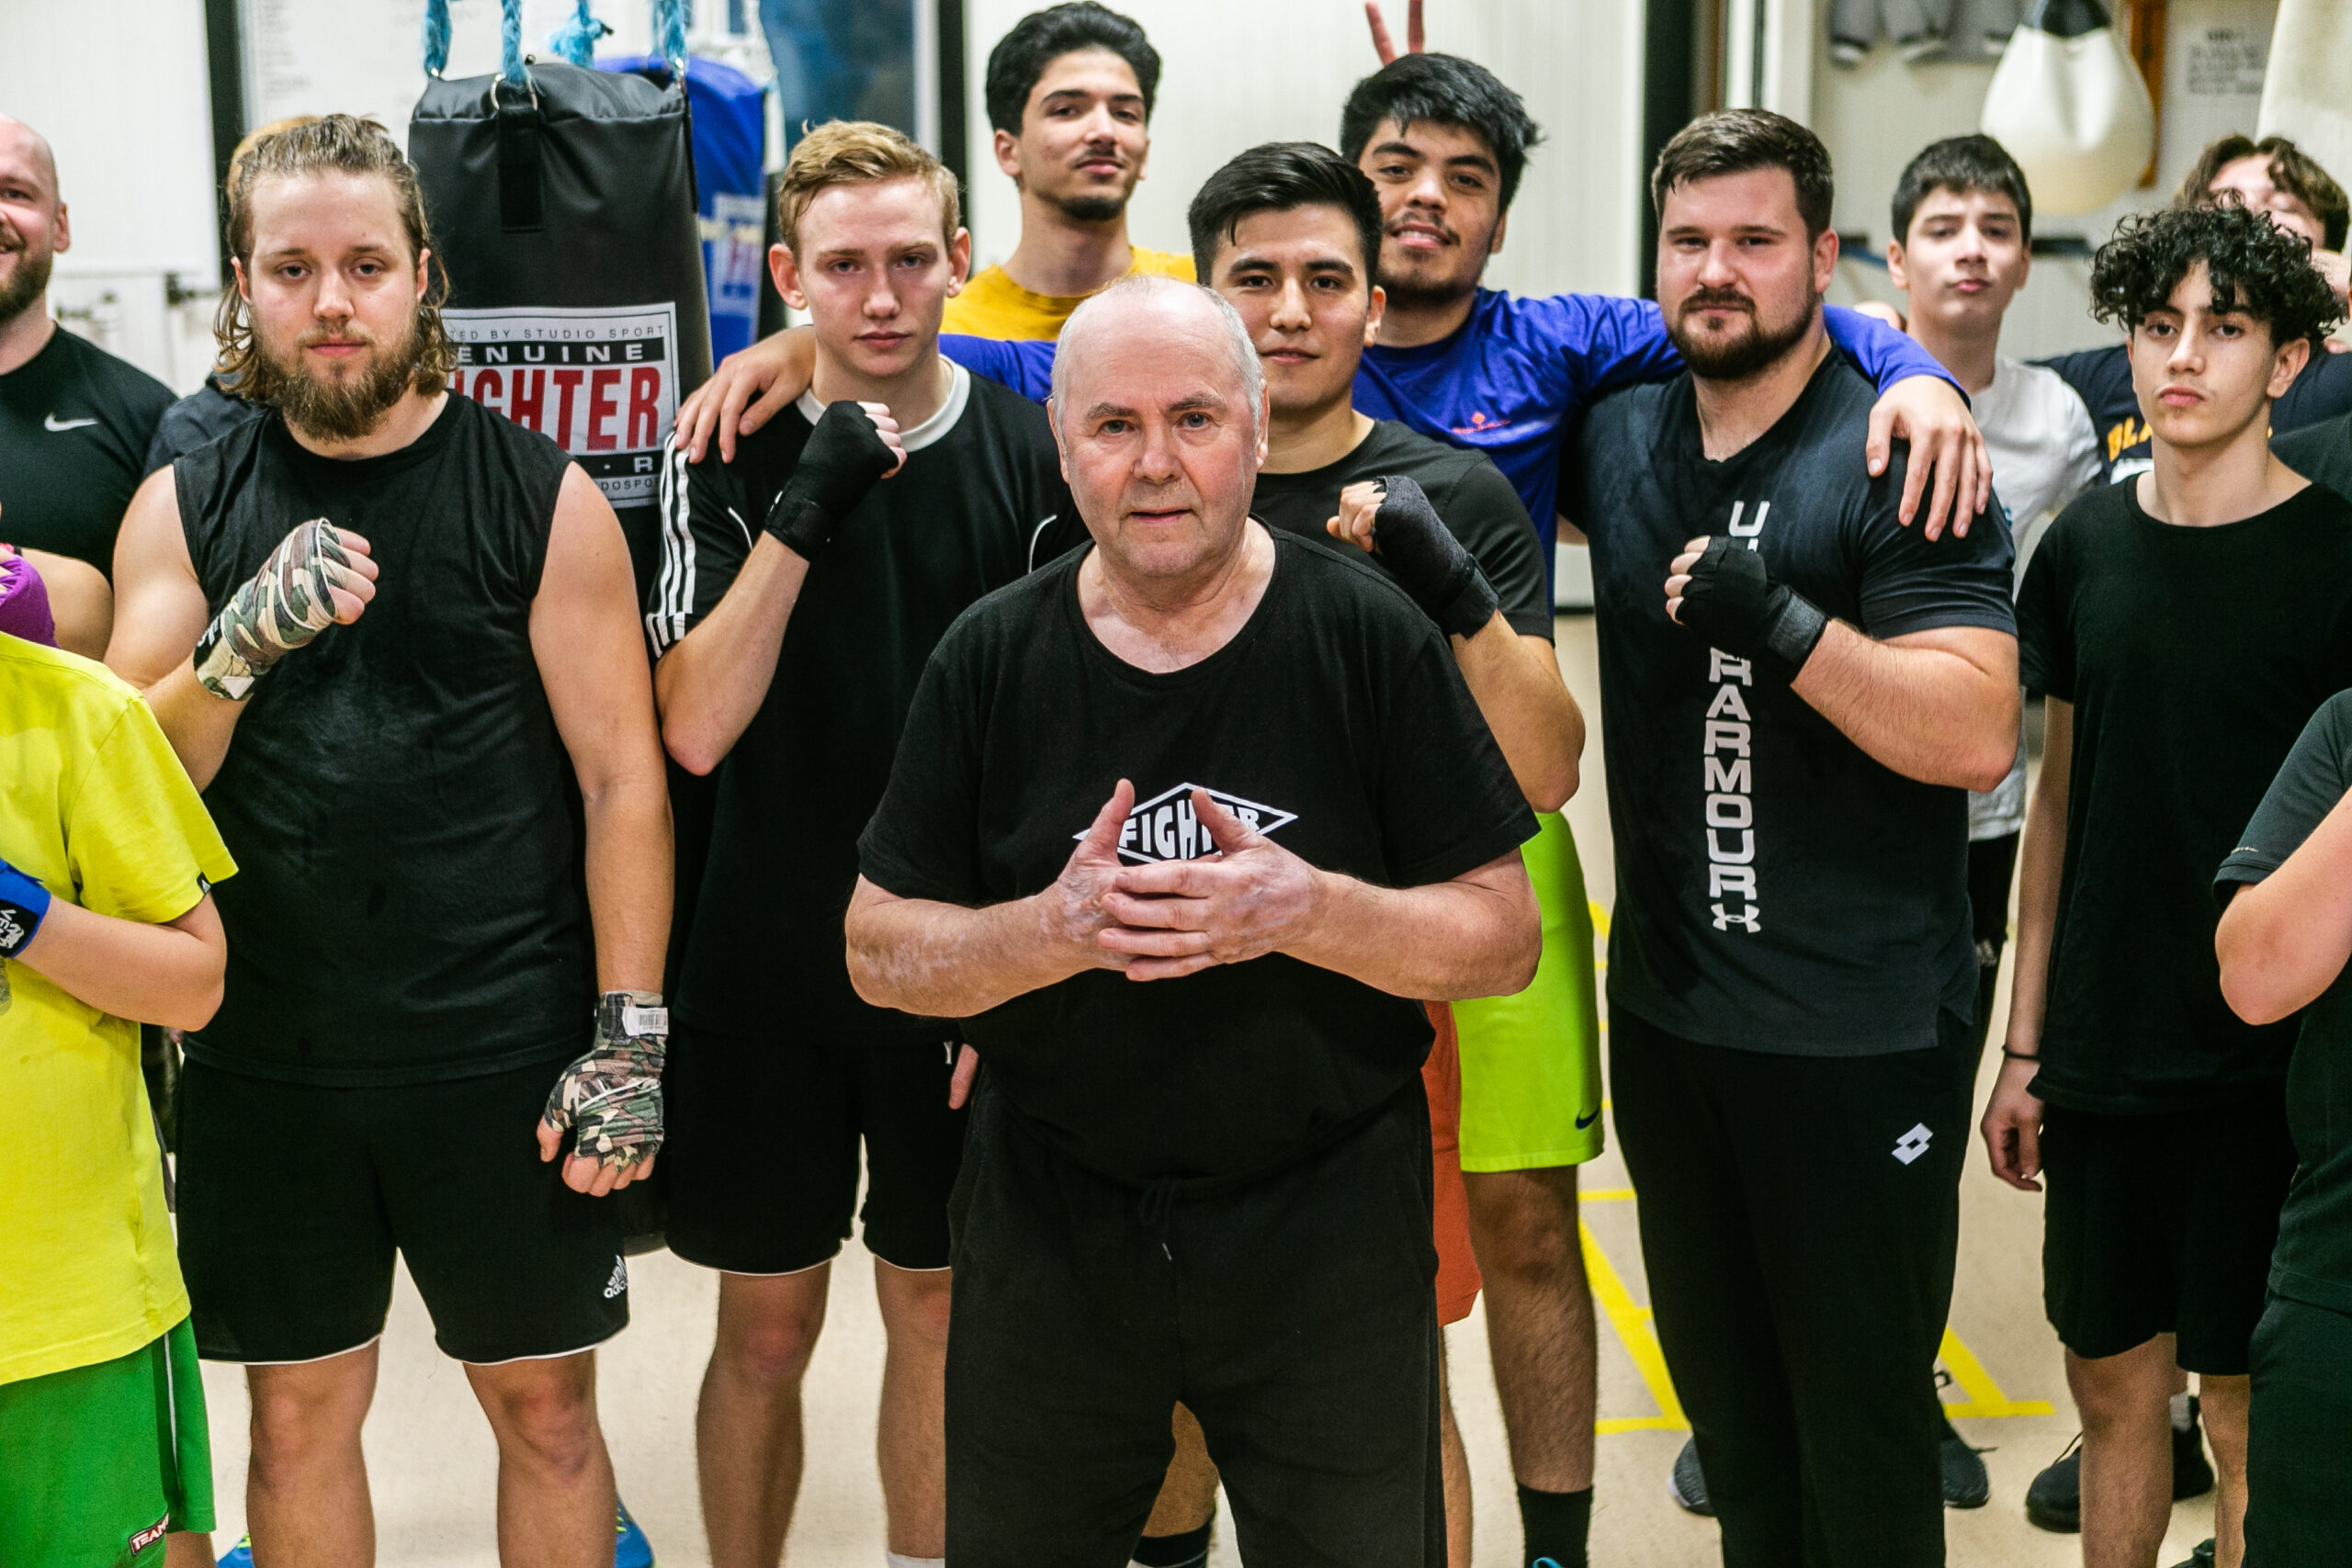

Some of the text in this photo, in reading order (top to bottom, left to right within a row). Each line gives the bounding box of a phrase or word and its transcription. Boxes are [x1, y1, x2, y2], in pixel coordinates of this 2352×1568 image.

[491, 330, 511, 340] BY
[524, 329, 595, 340] STUDIO
[609, 325, 663, 339] SPORT
[457, 344, 644, 363] ENUINE
[454, 367, 662, 452] GHTER
[601, 479, 661, 491] DOSPO
[1118, 798, 1261, 861] FIGHR
